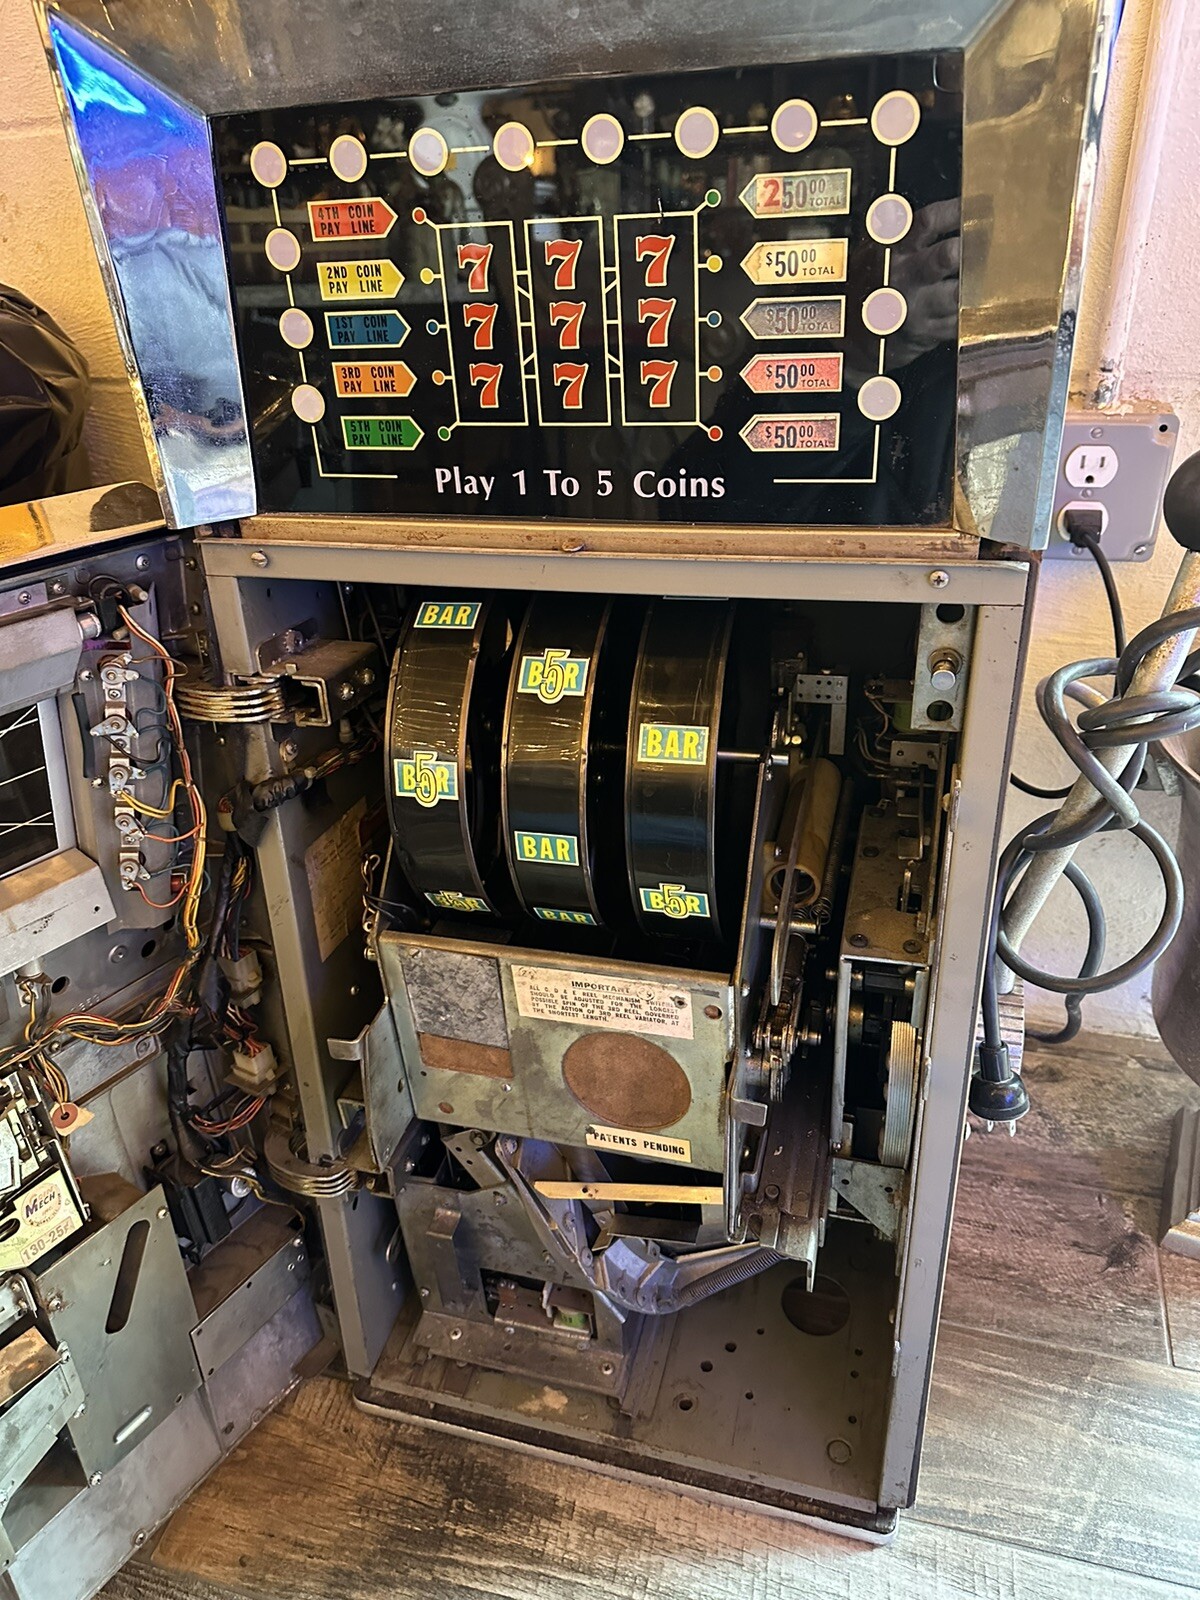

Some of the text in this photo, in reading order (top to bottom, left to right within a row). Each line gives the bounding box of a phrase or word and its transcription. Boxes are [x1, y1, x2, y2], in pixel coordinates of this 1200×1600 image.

[809, 196, 841, 207] TOTAL
[318, 204, 374, 220] 4TH COIN
[320, 220, 375, 235] PAY LINE
[457, 234, 676, 293] 7 7 7
[326, 264, 382, 279] 2ND COIN
[802, 266, 835, 276] TOTAL
[329, 280, 383, 294] PAY LINE
[335, 315, 388, 329] 1ST COIN
[463, 297, 676, 349] 7 7 7
[800, 321, 834, 331] TOTAL
[338, 330, 389, 343] PAY LINE
[341, 366, 395, 379] 3RD COIN
[344, 380, 396, 393] PAY LINE
[469, 359, 678, 409] 7 7 7
[800, 379, 831, 388] TOTAL
[350, 420, 402, 432] 5TH COIN
[352, 434, 404, 446] PAY LINE
[800, 439, 830, 448] TOTAL
[435, 466, 725, 500] Play 1 To 5 Coins
[422, 604, 471, 626] BAR
[645, 729, 700, 759] BAR
[522, 836, 571, 862] BAR
[543, 910, 587, 924] BAR
[571, 981, 630, 994] IMPORTANT
[530, 990, 554, 998] SHOULD
[574, 996, 604, 1005] ADJUSTED
[649, 1006, 678, 1014] LONGEST
[603, 994, 641, 1003] MECHANISM
[531, 996, 558, 1005] POSSIBLE
[645, 1011, 679, 1020] GOVERNED
[548, 1010, 579, 1018] SHORTEST
[561, 1005, 583, 1013] ACTION
[593, 1131, 685, 1155] PATENTS PENDING
[25, 1191, 56, 1219] MECH
